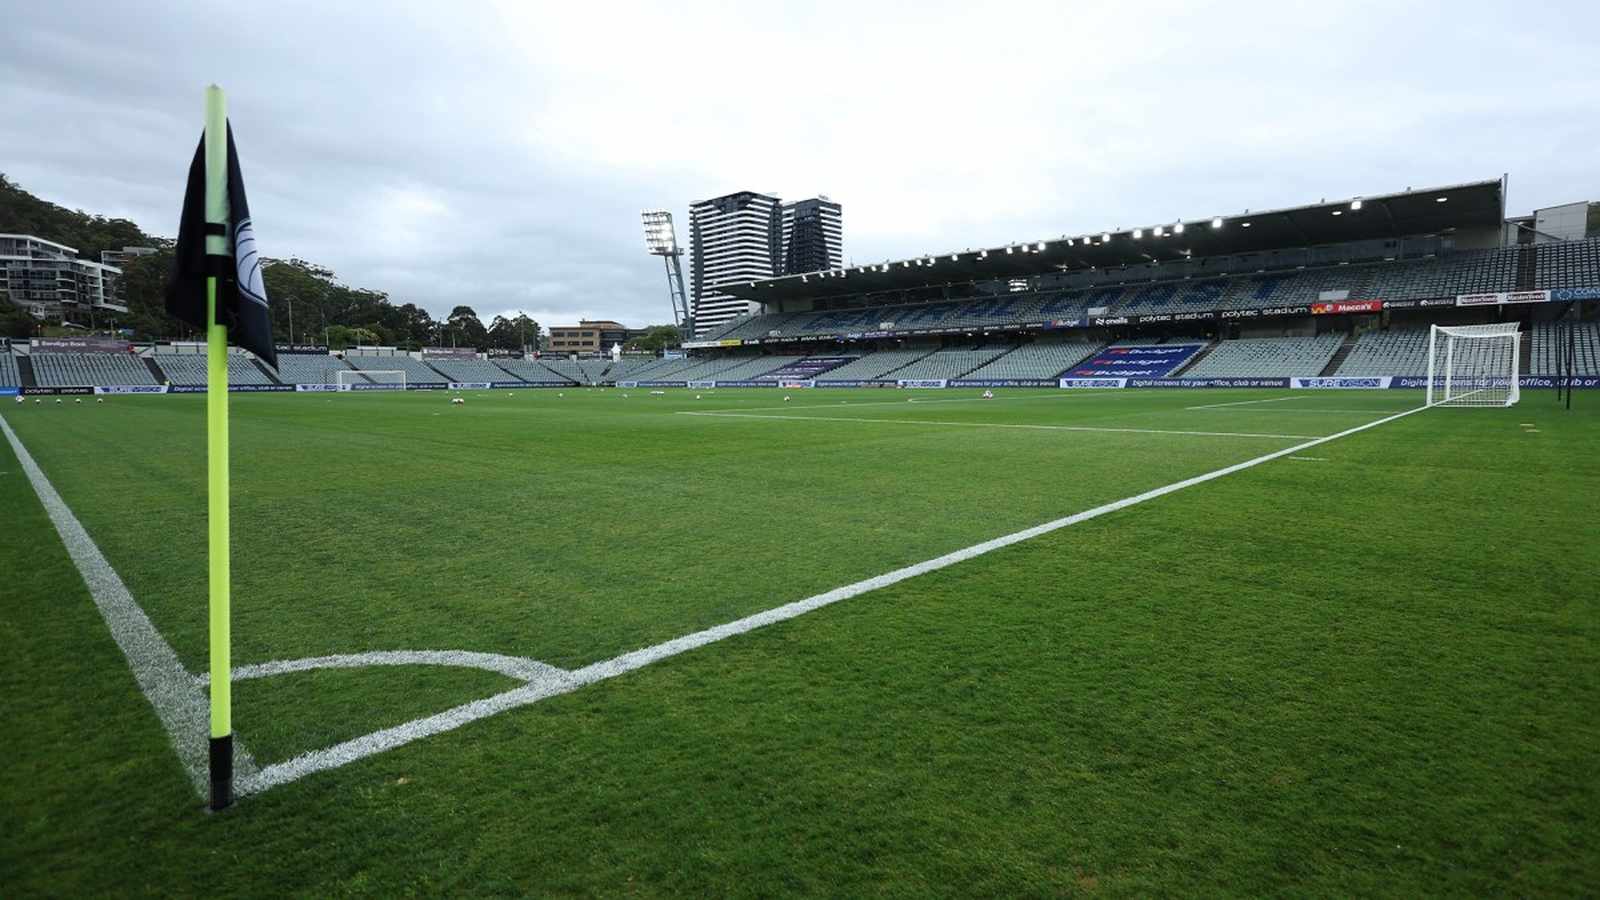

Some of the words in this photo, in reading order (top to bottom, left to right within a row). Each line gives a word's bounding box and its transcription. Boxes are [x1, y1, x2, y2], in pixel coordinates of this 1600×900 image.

[1222, 309, 1259, 319] polytec
[1263, 305, 1308, 315] stadium
[1338, 303, 1372, 312] Macca's
[1140, 314, 1171, 323] polytec
[1175, 311, 1214, 320] stadium
